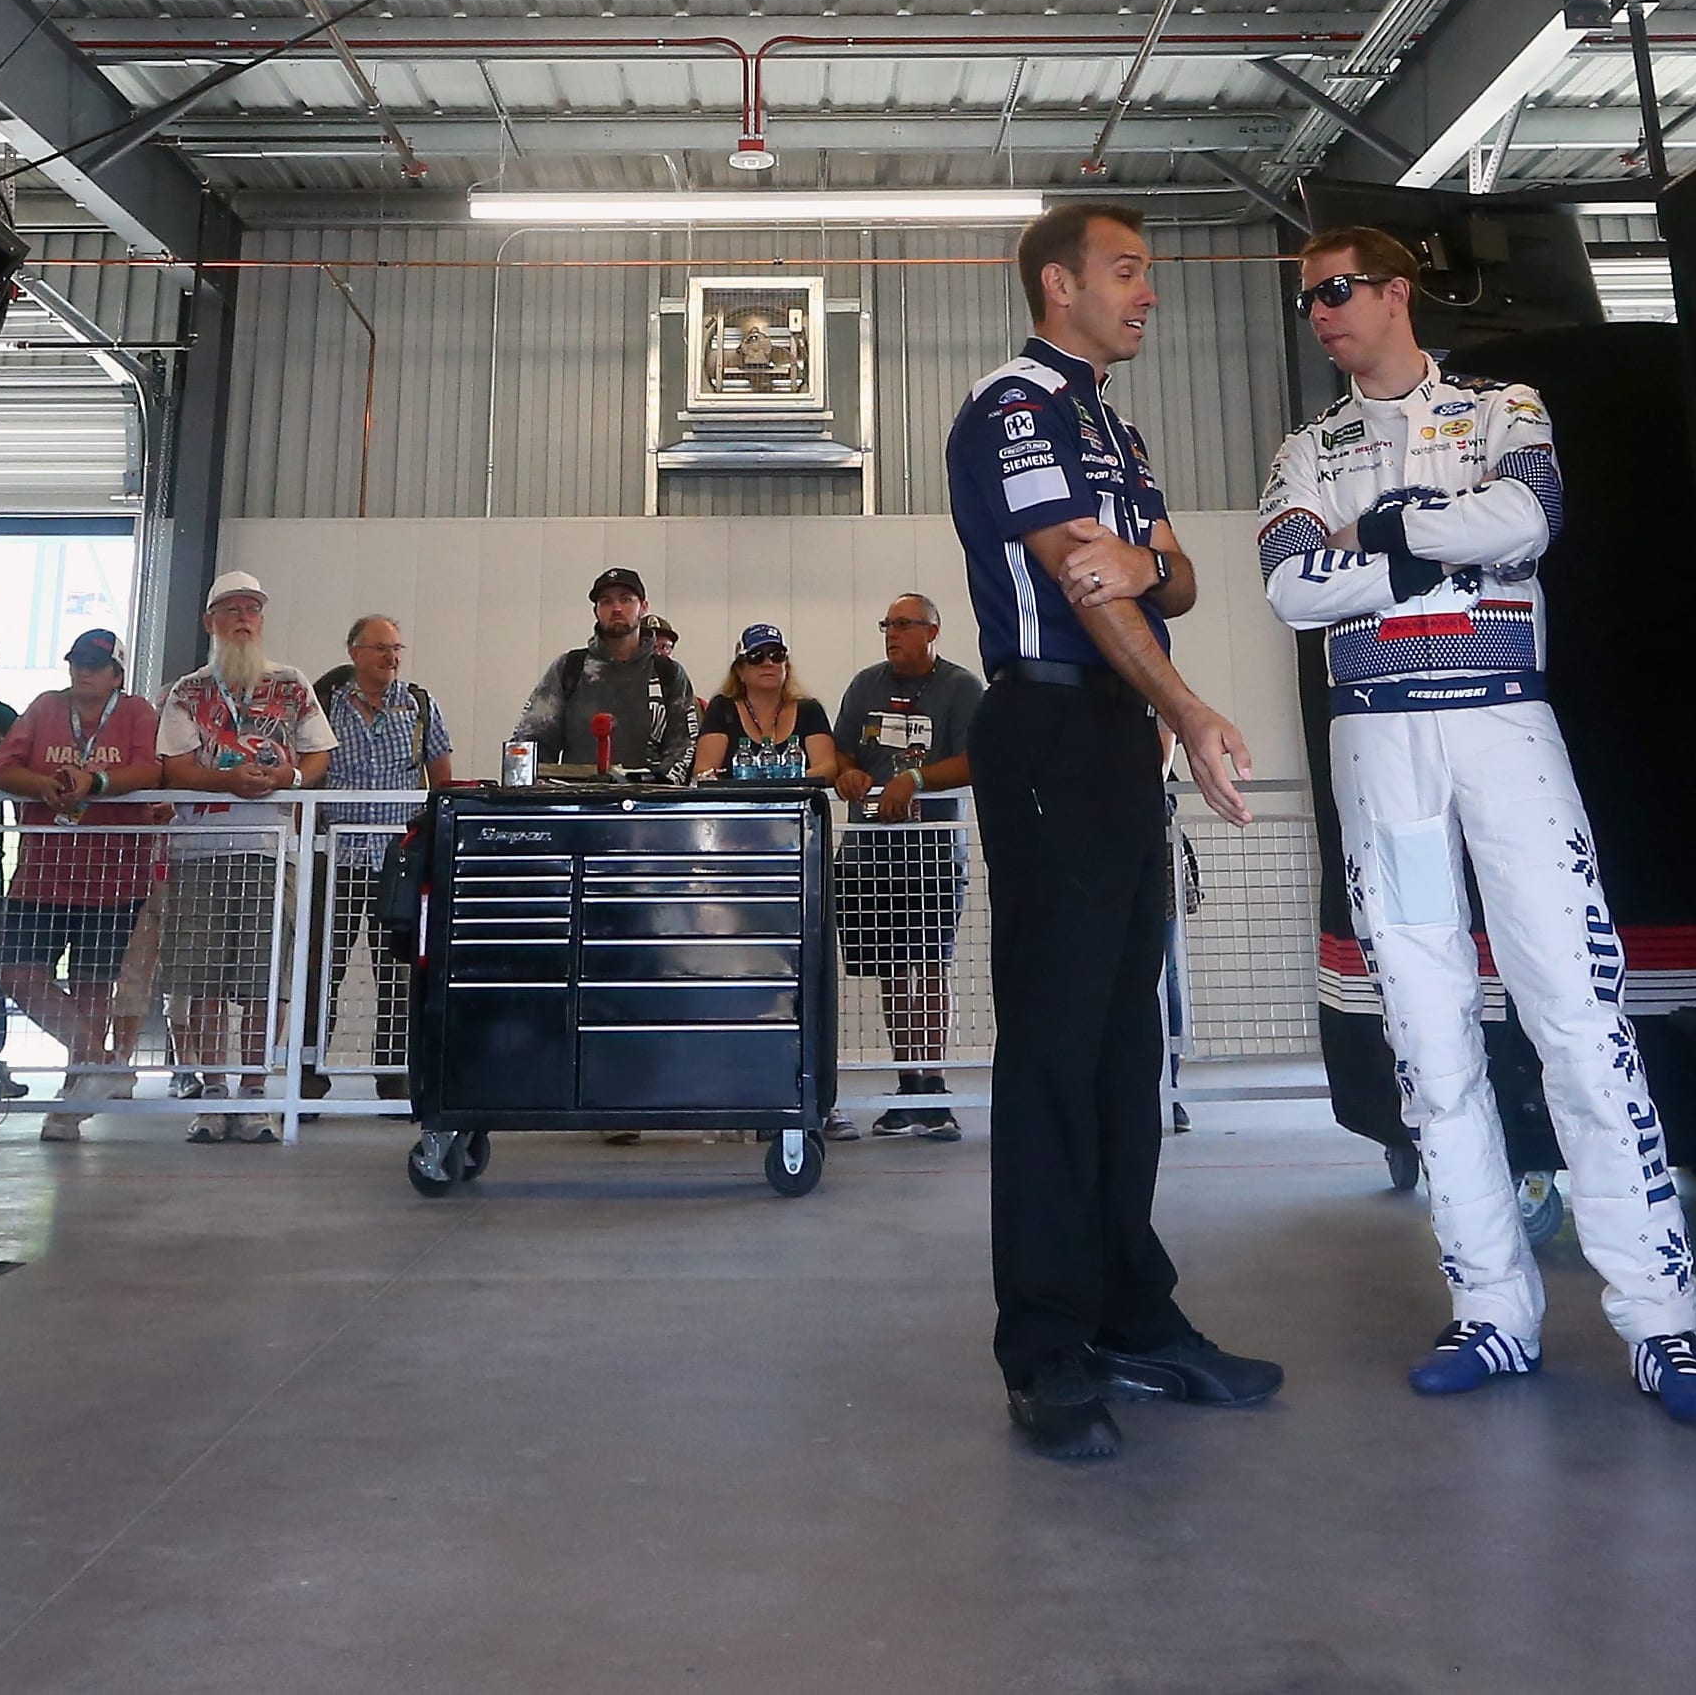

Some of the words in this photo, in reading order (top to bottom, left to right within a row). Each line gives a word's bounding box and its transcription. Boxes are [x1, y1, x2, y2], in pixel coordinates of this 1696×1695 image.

[1007, 415, 1033, 436] PPG
[1003, 453, 1055, 473] SIEMENS
[1407, 687, 1488, 700] KESELOWSKI
[1586, 905, 1625, 1005] Lite
[1627, 1102, 1676, 1210] Lite
